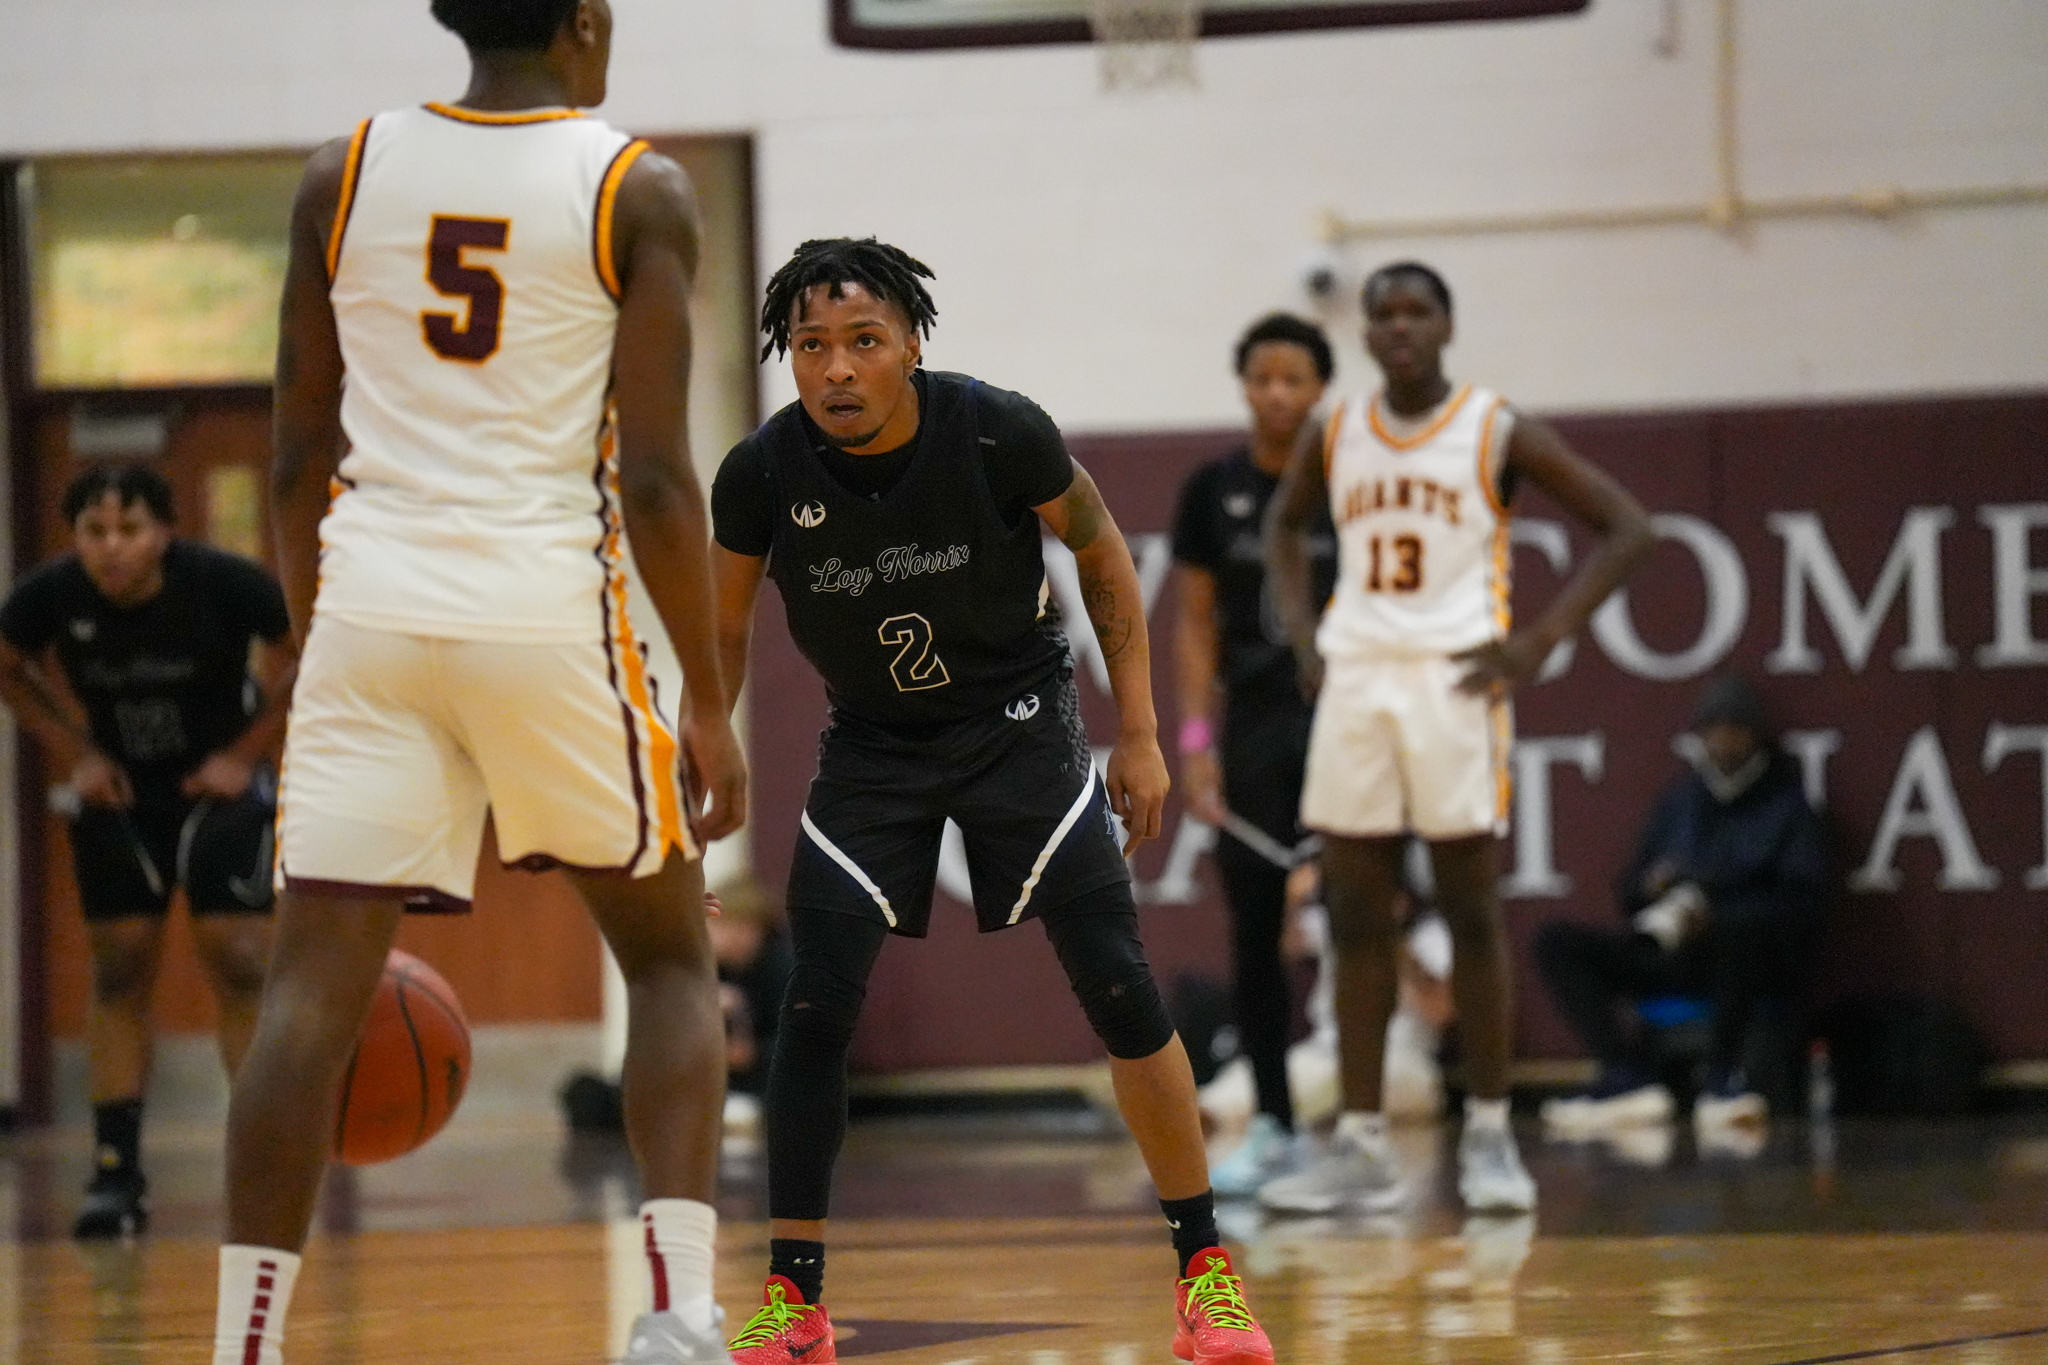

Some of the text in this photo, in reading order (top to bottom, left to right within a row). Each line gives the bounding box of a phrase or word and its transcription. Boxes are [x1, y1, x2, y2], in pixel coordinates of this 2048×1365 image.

[420, 213, 512, 369] 5
[809, 543, 970, 597] Loy Norrix
[1365, 532, 1425, 594] 13
[877, 612, 951, 692] 2
